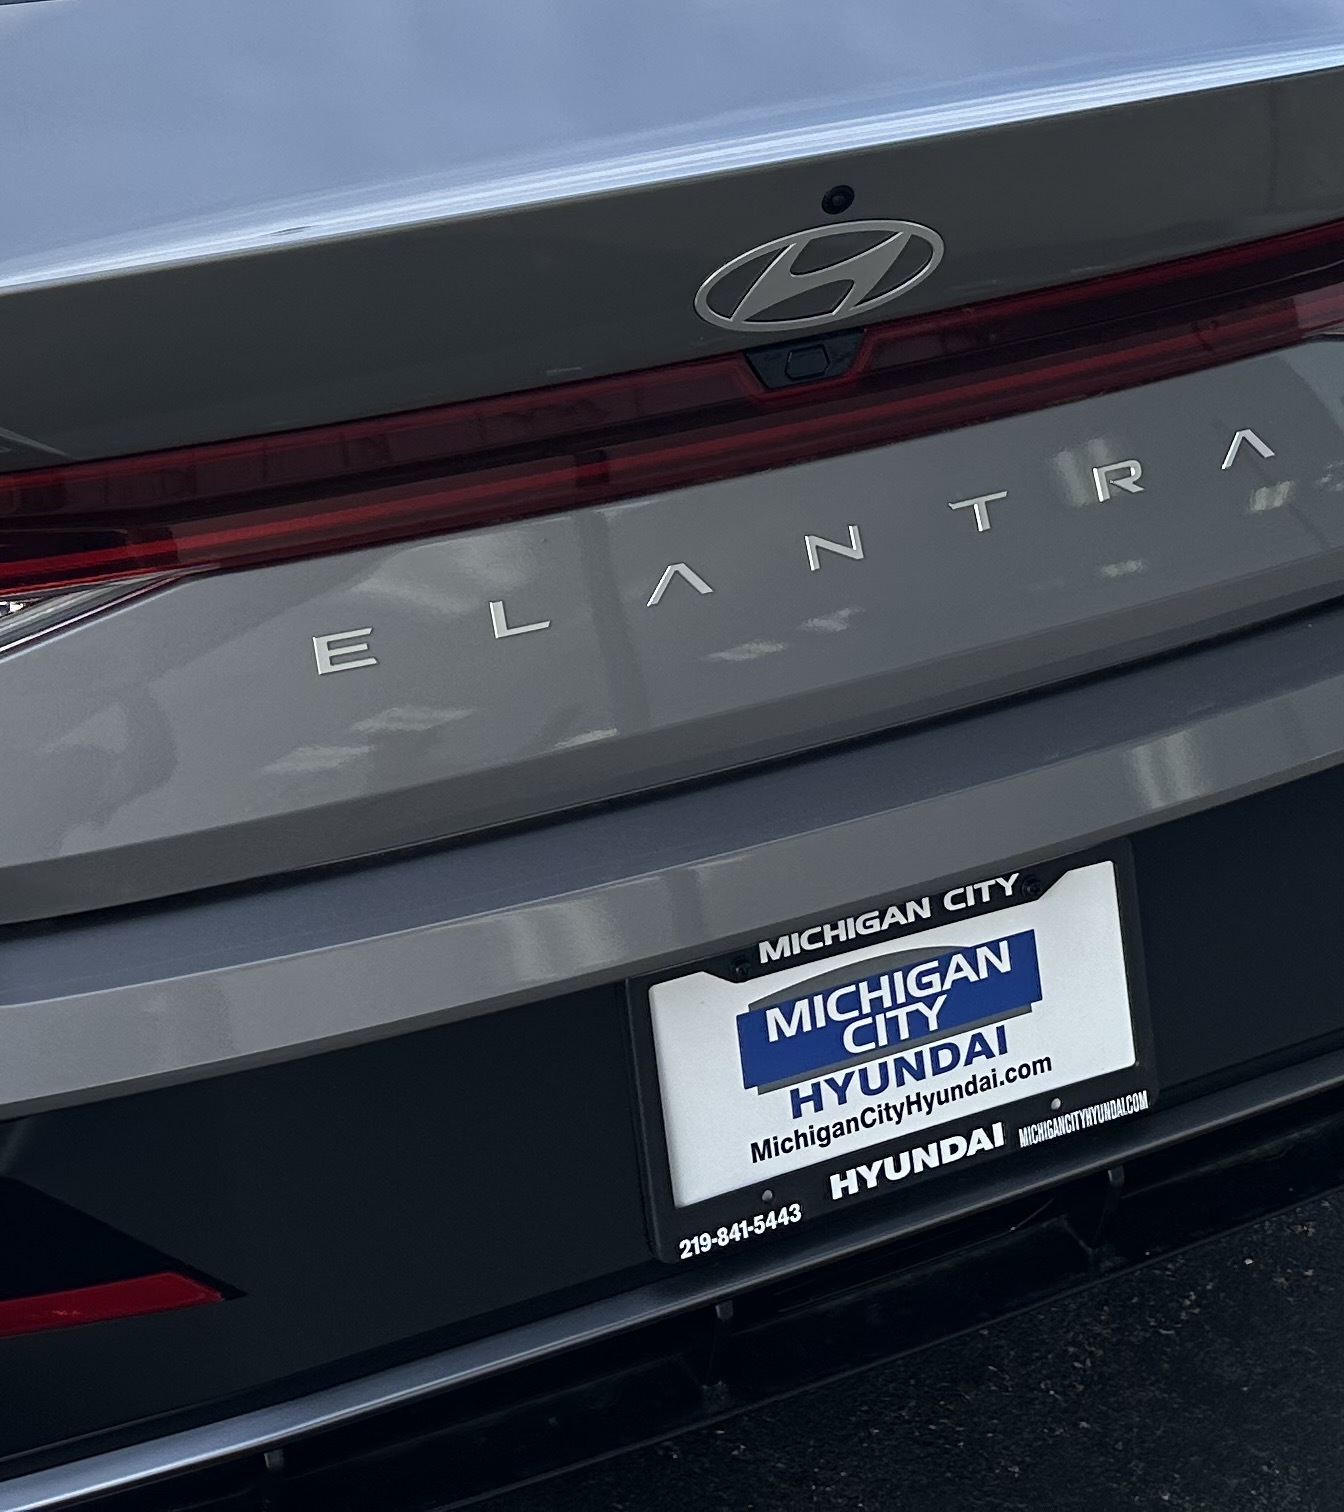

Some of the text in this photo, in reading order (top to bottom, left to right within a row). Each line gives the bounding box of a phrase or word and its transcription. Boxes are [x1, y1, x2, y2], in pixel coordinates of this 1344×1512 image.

[312, 427, 1275, 675] ELANTRA
[758, 872, 1020, 964] MICHIGAN CITY
[765, 939, 1013, 1043] MICHIGAN
[842, 995, 948, 1055] CITY
[750, 1055, 1053, 1164] MichiganCityHyundai.com
[789, 1024, 1008, 1120] HYUNDAI
[829, 1121, 1006, 1201] HYUNDAI
[678, 1202, 803, 1260] 219-841-5443
